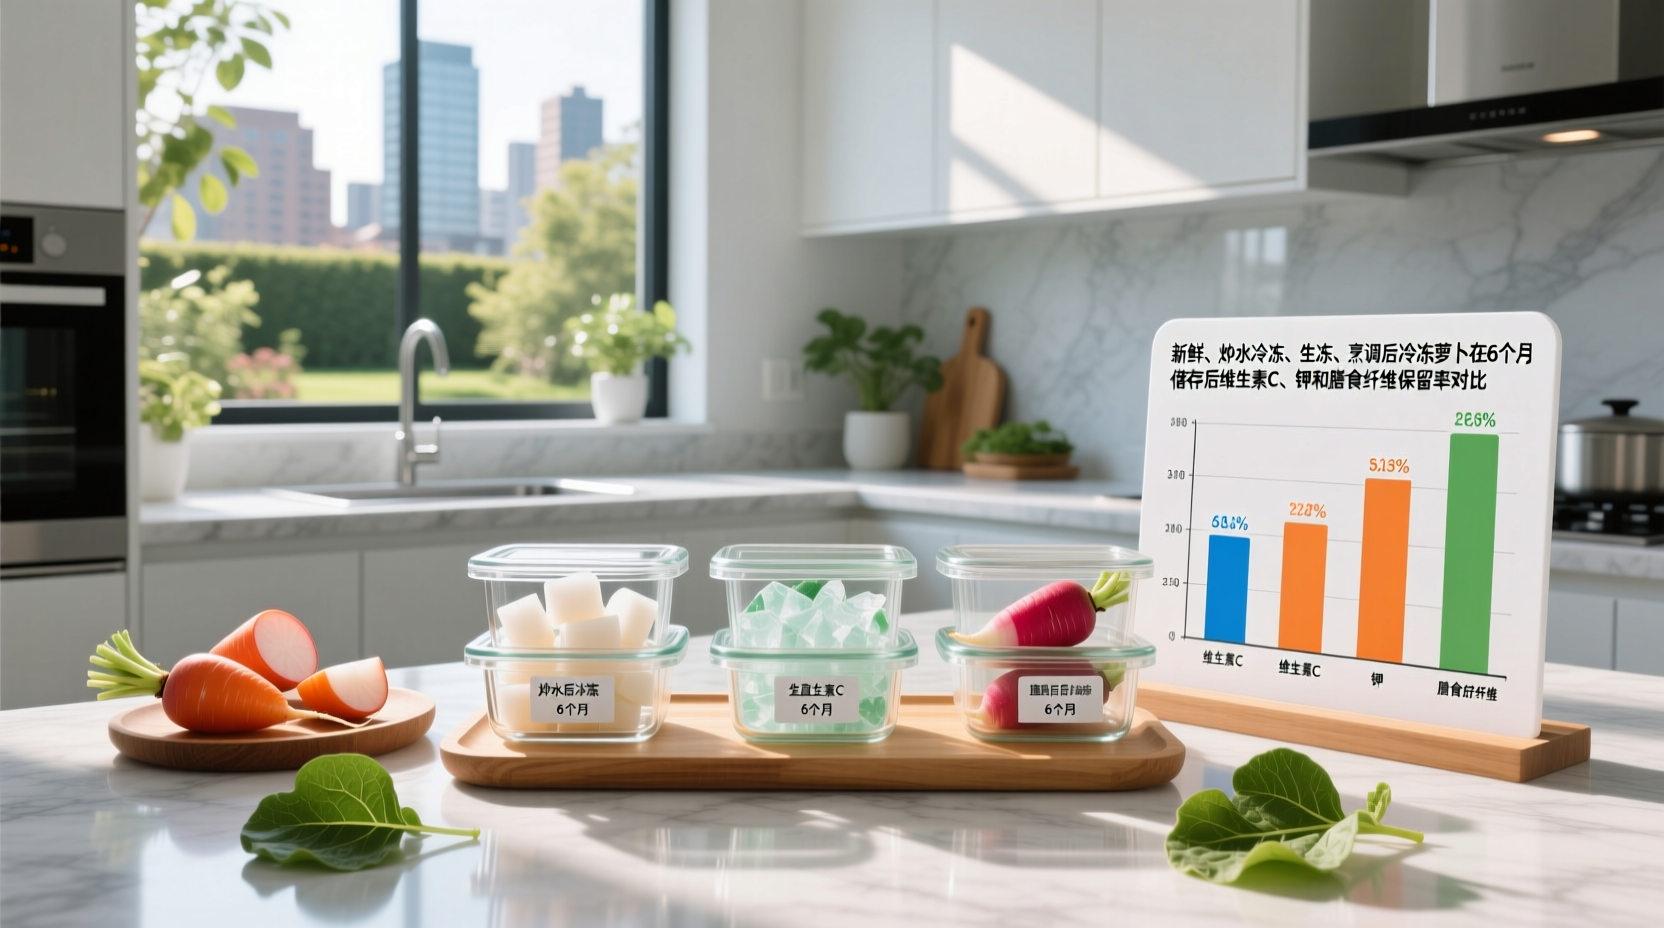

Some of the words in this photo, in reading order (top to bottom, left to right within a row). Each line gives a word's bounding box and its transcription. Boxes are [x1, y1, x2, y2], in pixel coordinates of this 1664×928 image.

[556, 702, 589, 717] 6个月
[800, 702, 833, 717] 6个月
[1044, 702, 1076, 717] 6个月
